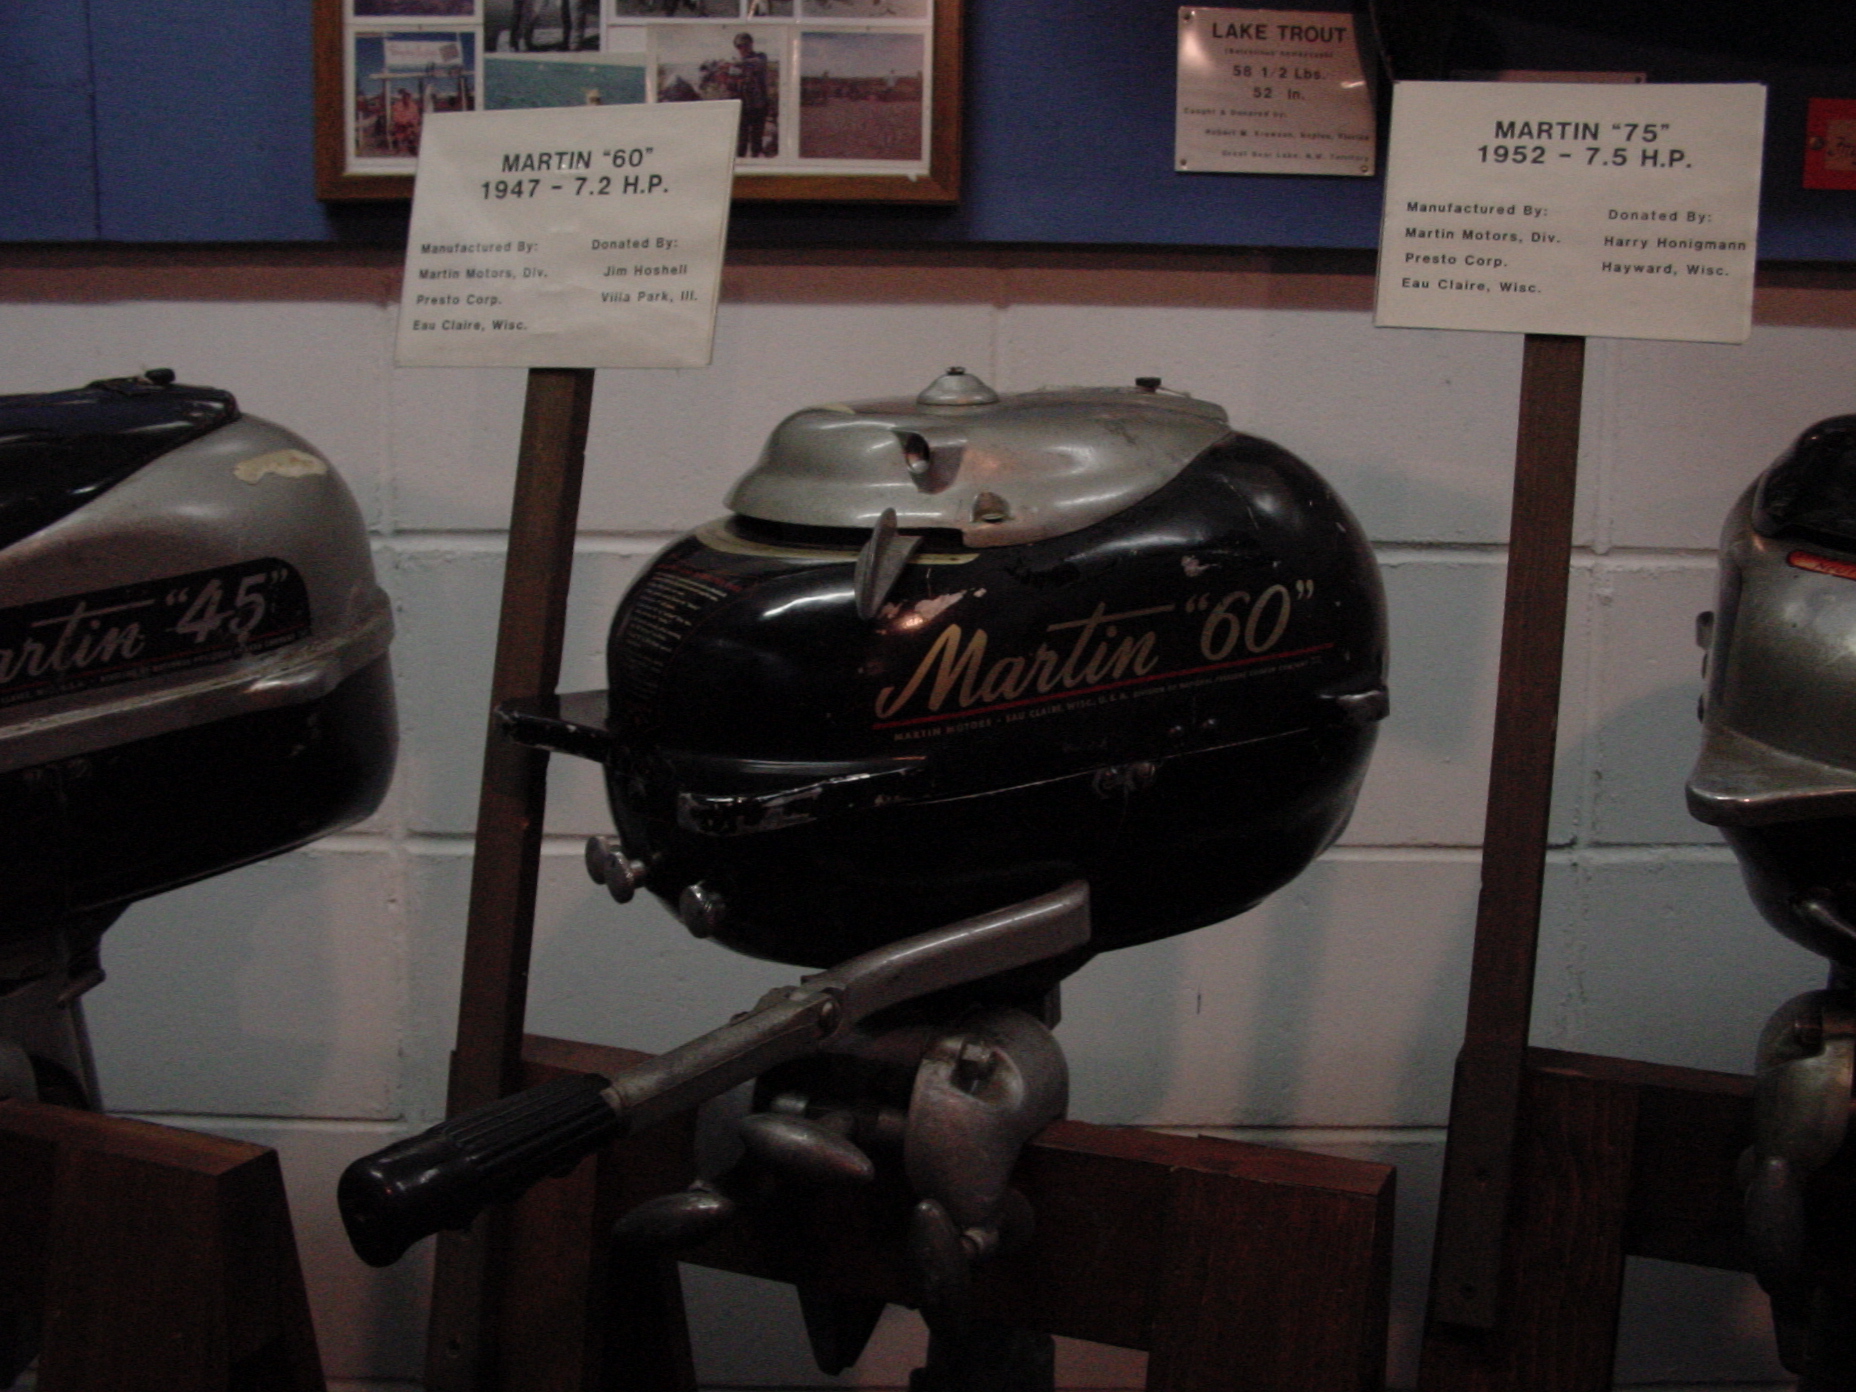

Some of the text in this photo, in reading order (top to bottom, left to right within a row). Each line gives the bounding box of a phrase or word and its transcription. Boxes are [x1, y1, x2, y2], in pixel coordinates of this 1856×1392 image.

[1212, 22, 1348, 43] LAKE TROUT
[1233, 65, 1252, 78] 58
[1295, 68, 1326, 80] Lbs.
[1253, 87, 1273, 99] 52
[1494, 121, 1671, 143] MARTIN “75”
[501, 147, 654, 173] MARTIN “60”
[1478, 145, 1546, 164] 1952
[1585, 147, 1628, 166] 7.5
[1640, 149, 1693, 168] H.P.
[481, 179, 541, 200] 1947
[575, 176, 612, 196] 7.2
[623, 174, 669, 194] H.P.
[1407, 202, 1549, 218] Manufactured By:
[1608, 209, 1712, 225] Donated By:
[1405, 227, 1561, 243] Martin Motors, Div.
[420, 241, 538, 255] Manufactured By:
[591, 237, 678, 251] Donated By:
[1604, 236, 1747, 252] Harry Honigmann
[1405, 253, 1508, 268] Presto Corp.
[419, 267, 548, 281] Martin Motors, Div.
[603, 265, 628, 277] Jim
[1601, 262, 1730, 276] Hayward, Wisc.
[1402, 277, 1542, 294] Eau Claire, Wisc.
[416, 294, 502, 307] Presto Corp.
[601, 291, 631, 302] Villa
[637, 291, 674, 304] Park,
[412, 320, 528, 333] Eau Claire, Wisc.
[874, 602, 1176, 719] Martin
[1185, 579, 1314, 661] “60”
